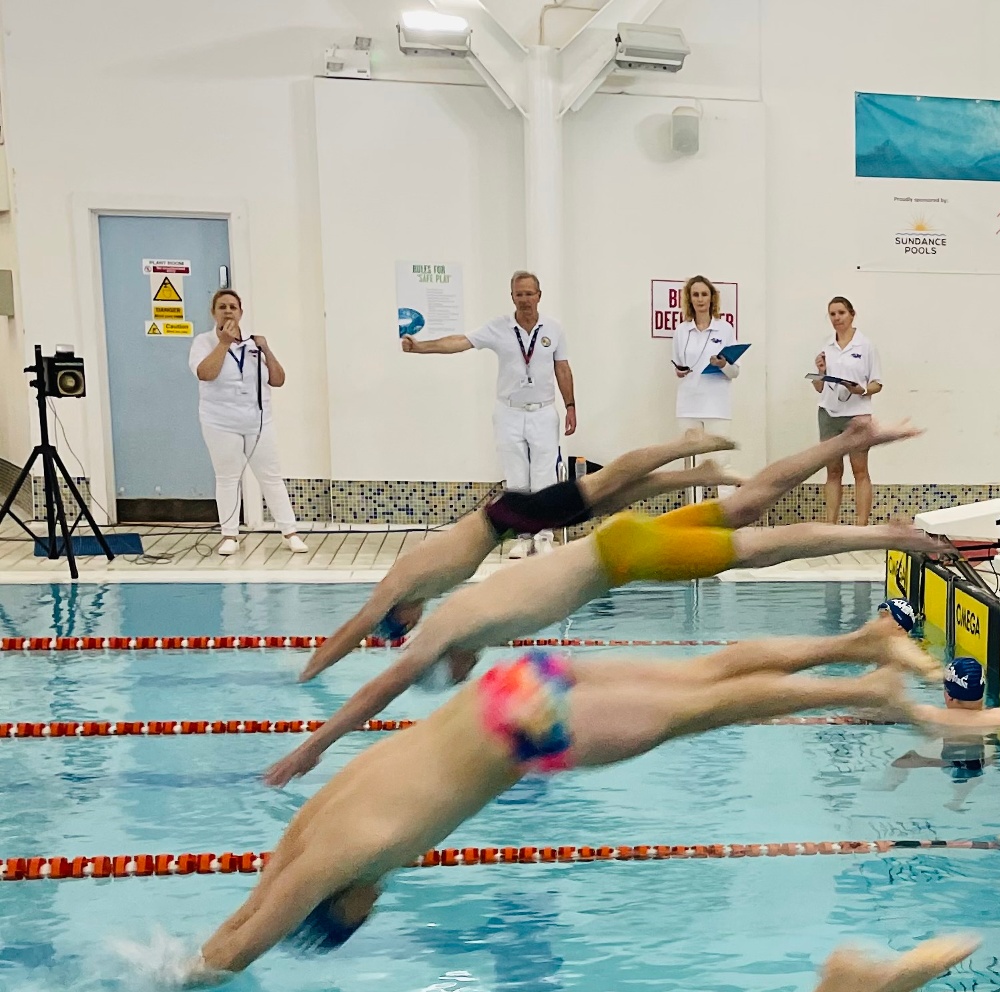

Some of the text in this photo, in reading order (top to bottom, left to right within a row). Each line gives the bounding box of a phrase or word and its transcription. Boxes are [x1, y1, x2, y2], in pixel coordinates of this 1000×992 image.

[895, 237, 947, 246] SUNDANCE
[904, 246, 937, 255] POOLS
[655, 311, 683, 330] DEE
[956, 603, 980, 635] OMEGA
